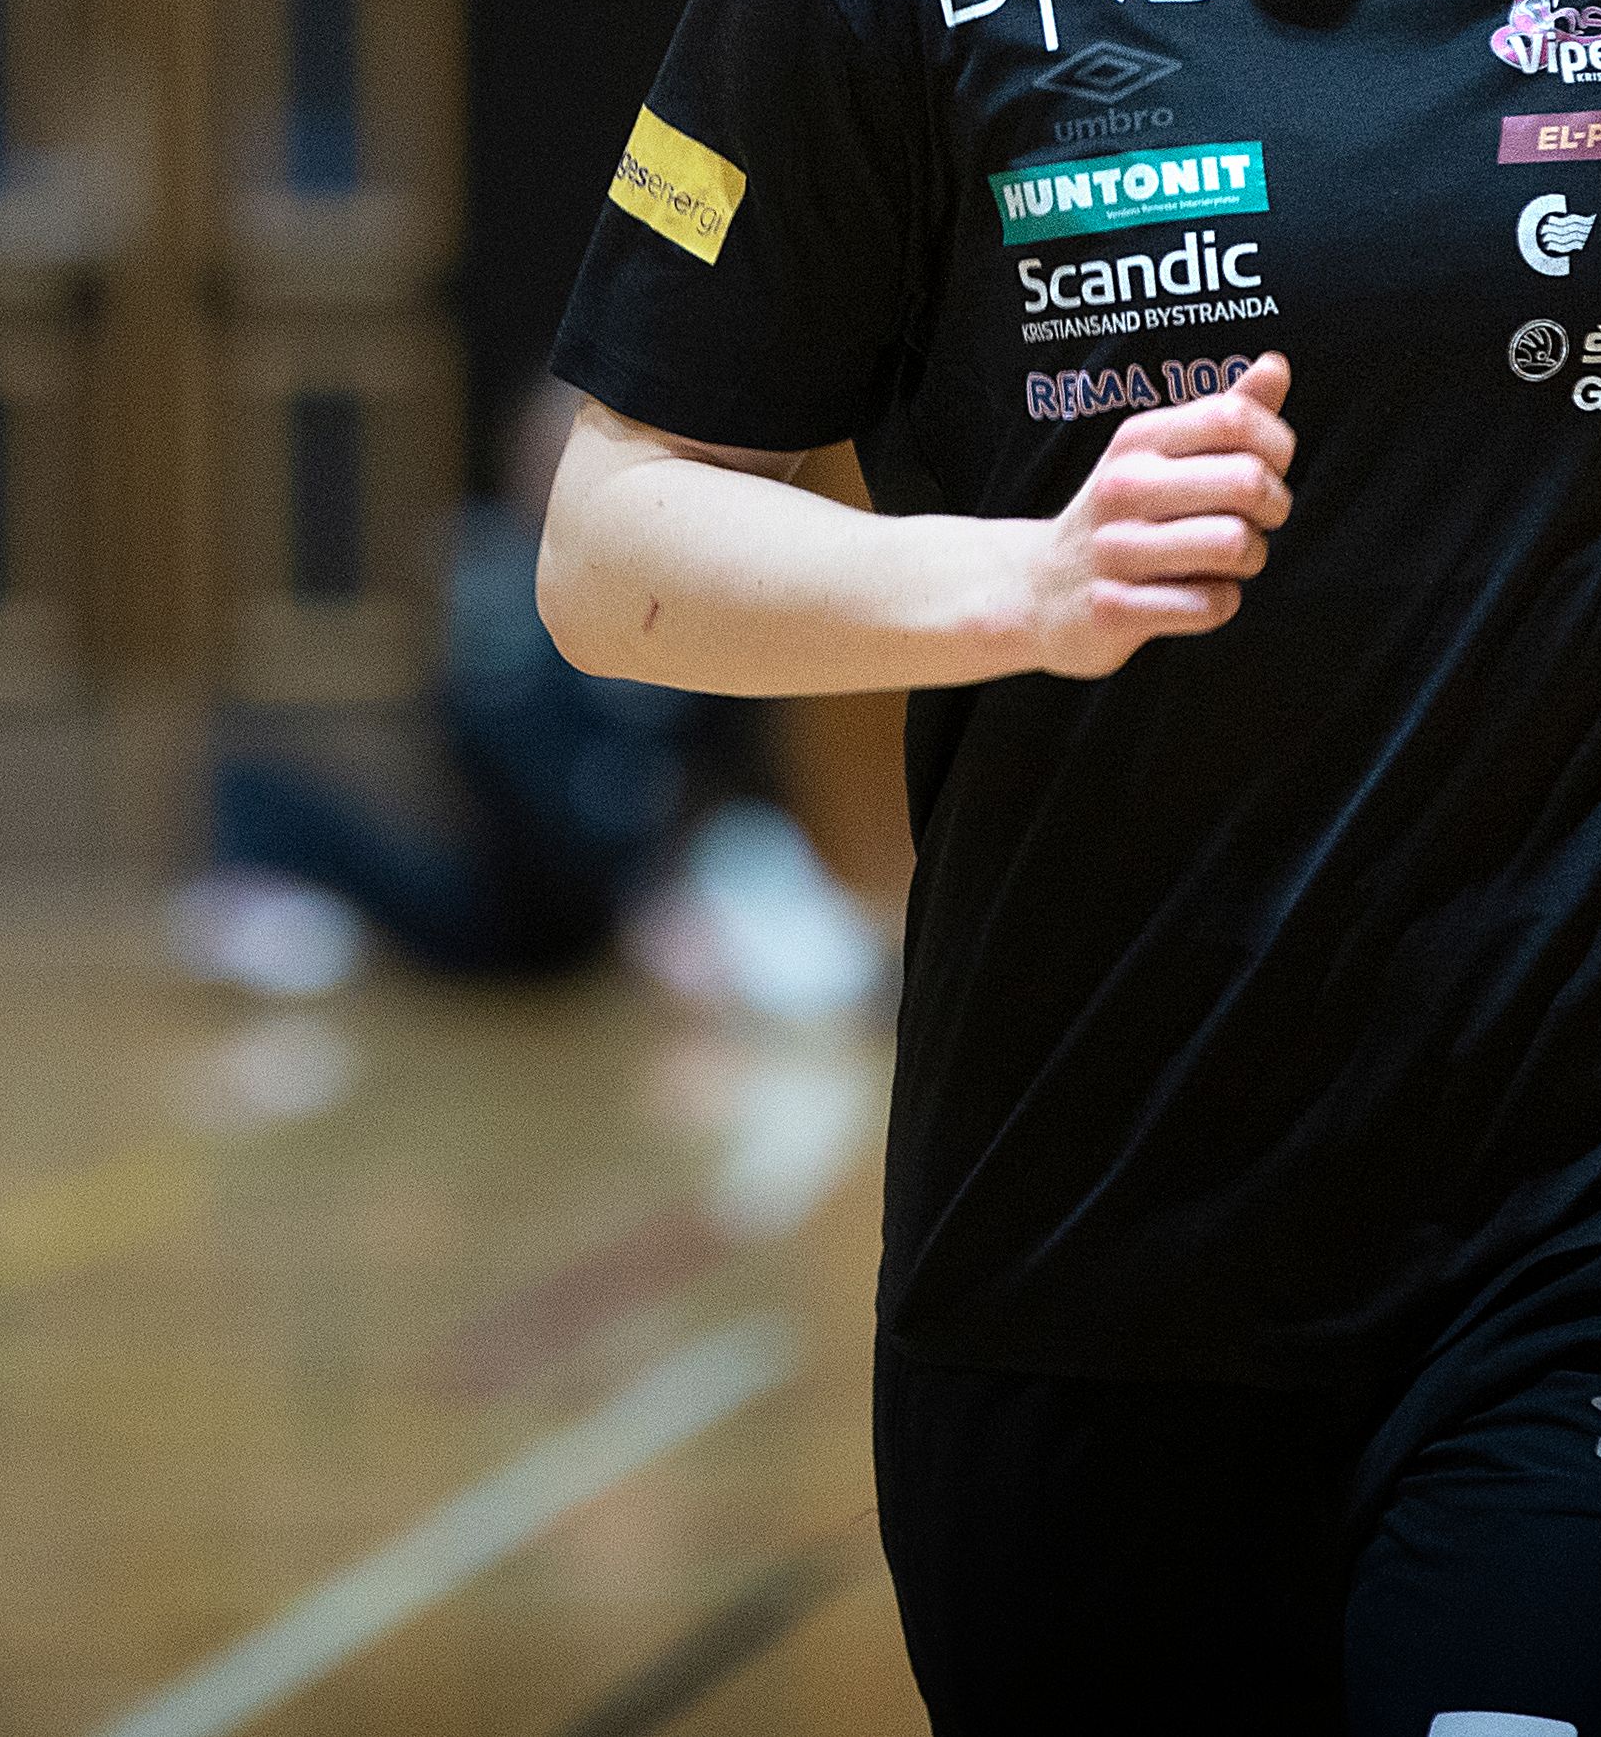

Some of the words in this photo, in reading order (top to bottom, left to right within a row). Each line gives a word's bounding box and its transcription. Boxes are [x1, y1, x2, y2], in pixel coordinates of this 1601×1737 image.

[1054, 107, 1175, 143] umbro
[1002, 154, 1251, 221] HUNTONIT
[1018, 231, 1262, 314] Scandic
[1021, 311, 1141, 344] KRISTIANSAND
[1145, 296, 1279, 330] BYSTRANDA
[1026, 362, 1161, 422] REMA
